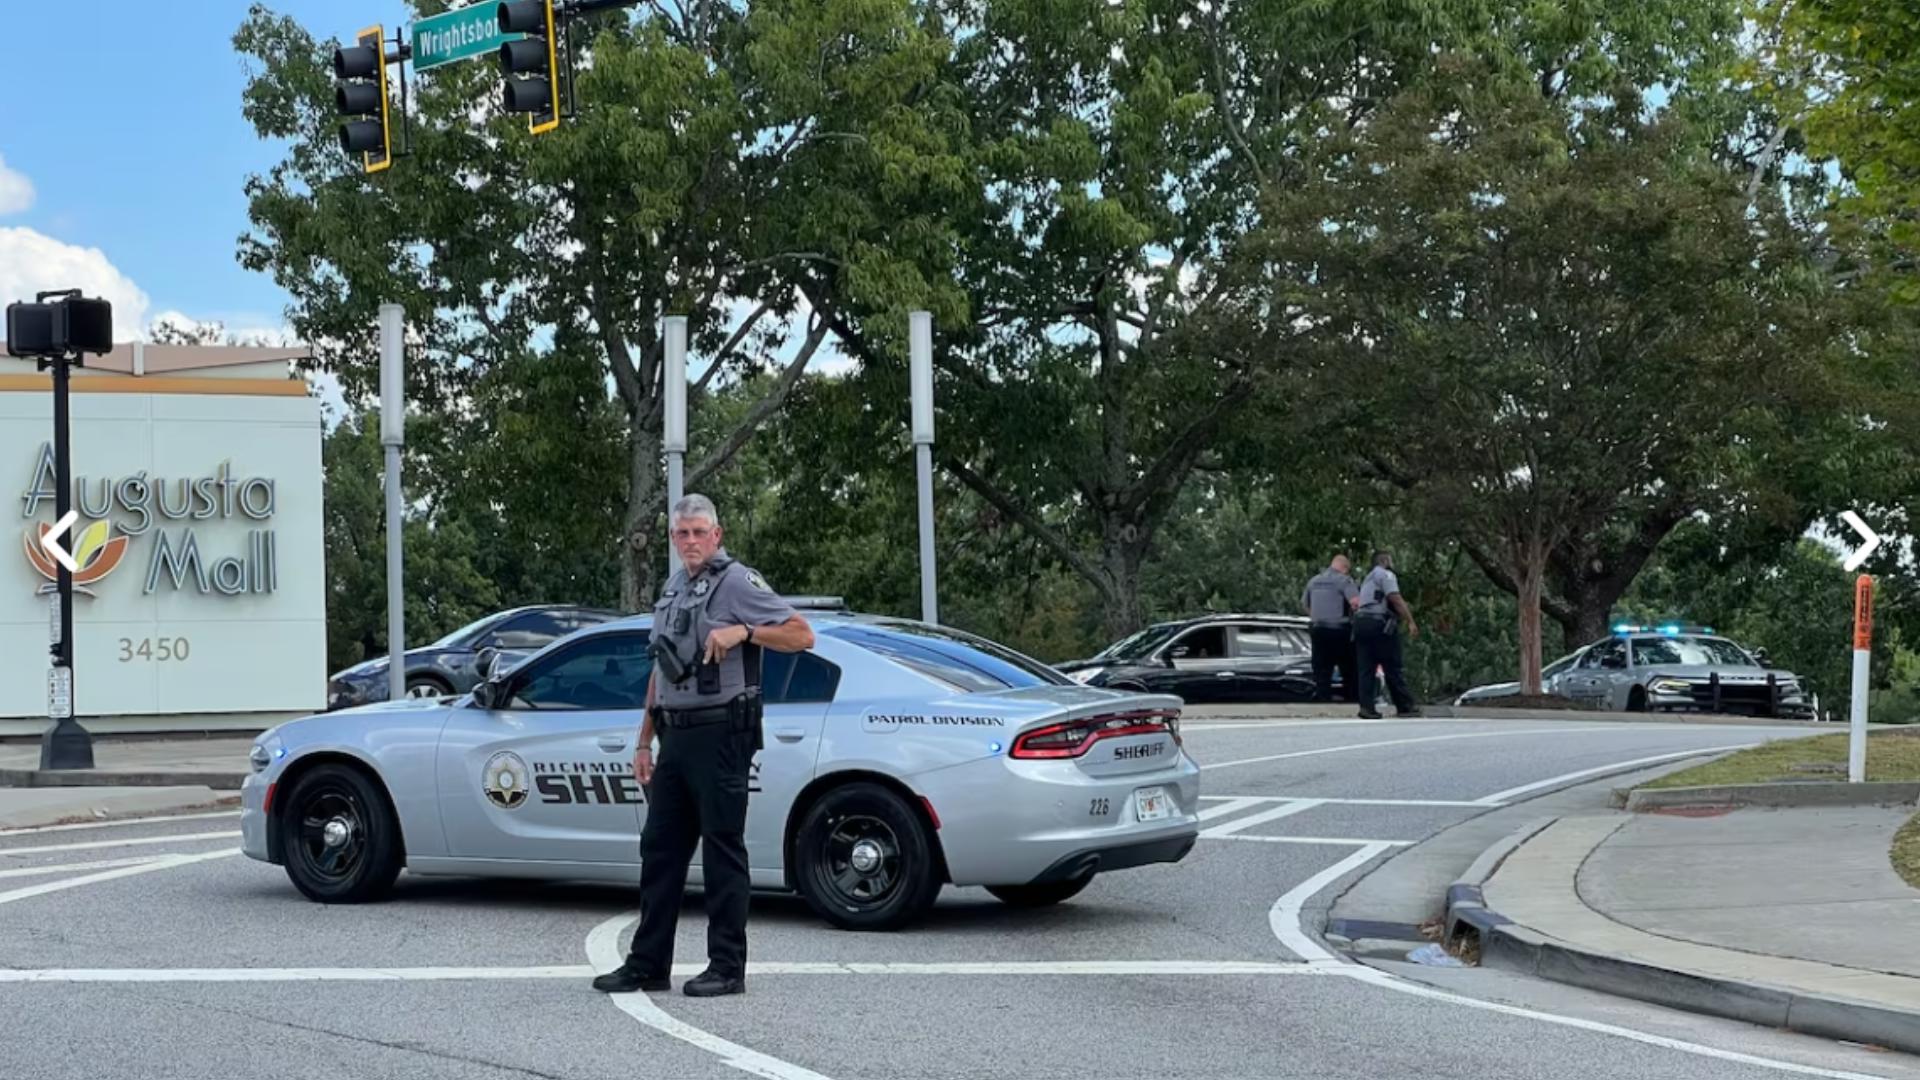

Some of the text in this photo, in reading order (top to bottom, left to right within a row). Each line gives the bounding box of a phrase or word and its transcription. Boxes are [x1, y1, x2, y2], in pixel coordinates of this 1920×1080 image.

[22, 441, 277, 536] Augusta
[143, 527, 278, 594] Mall
[118, 637, 190, 662] 3450
[867, 714, 1006, 727] PATROL DIVISION
[1114, 742, 1165, 760] SHERIFF
